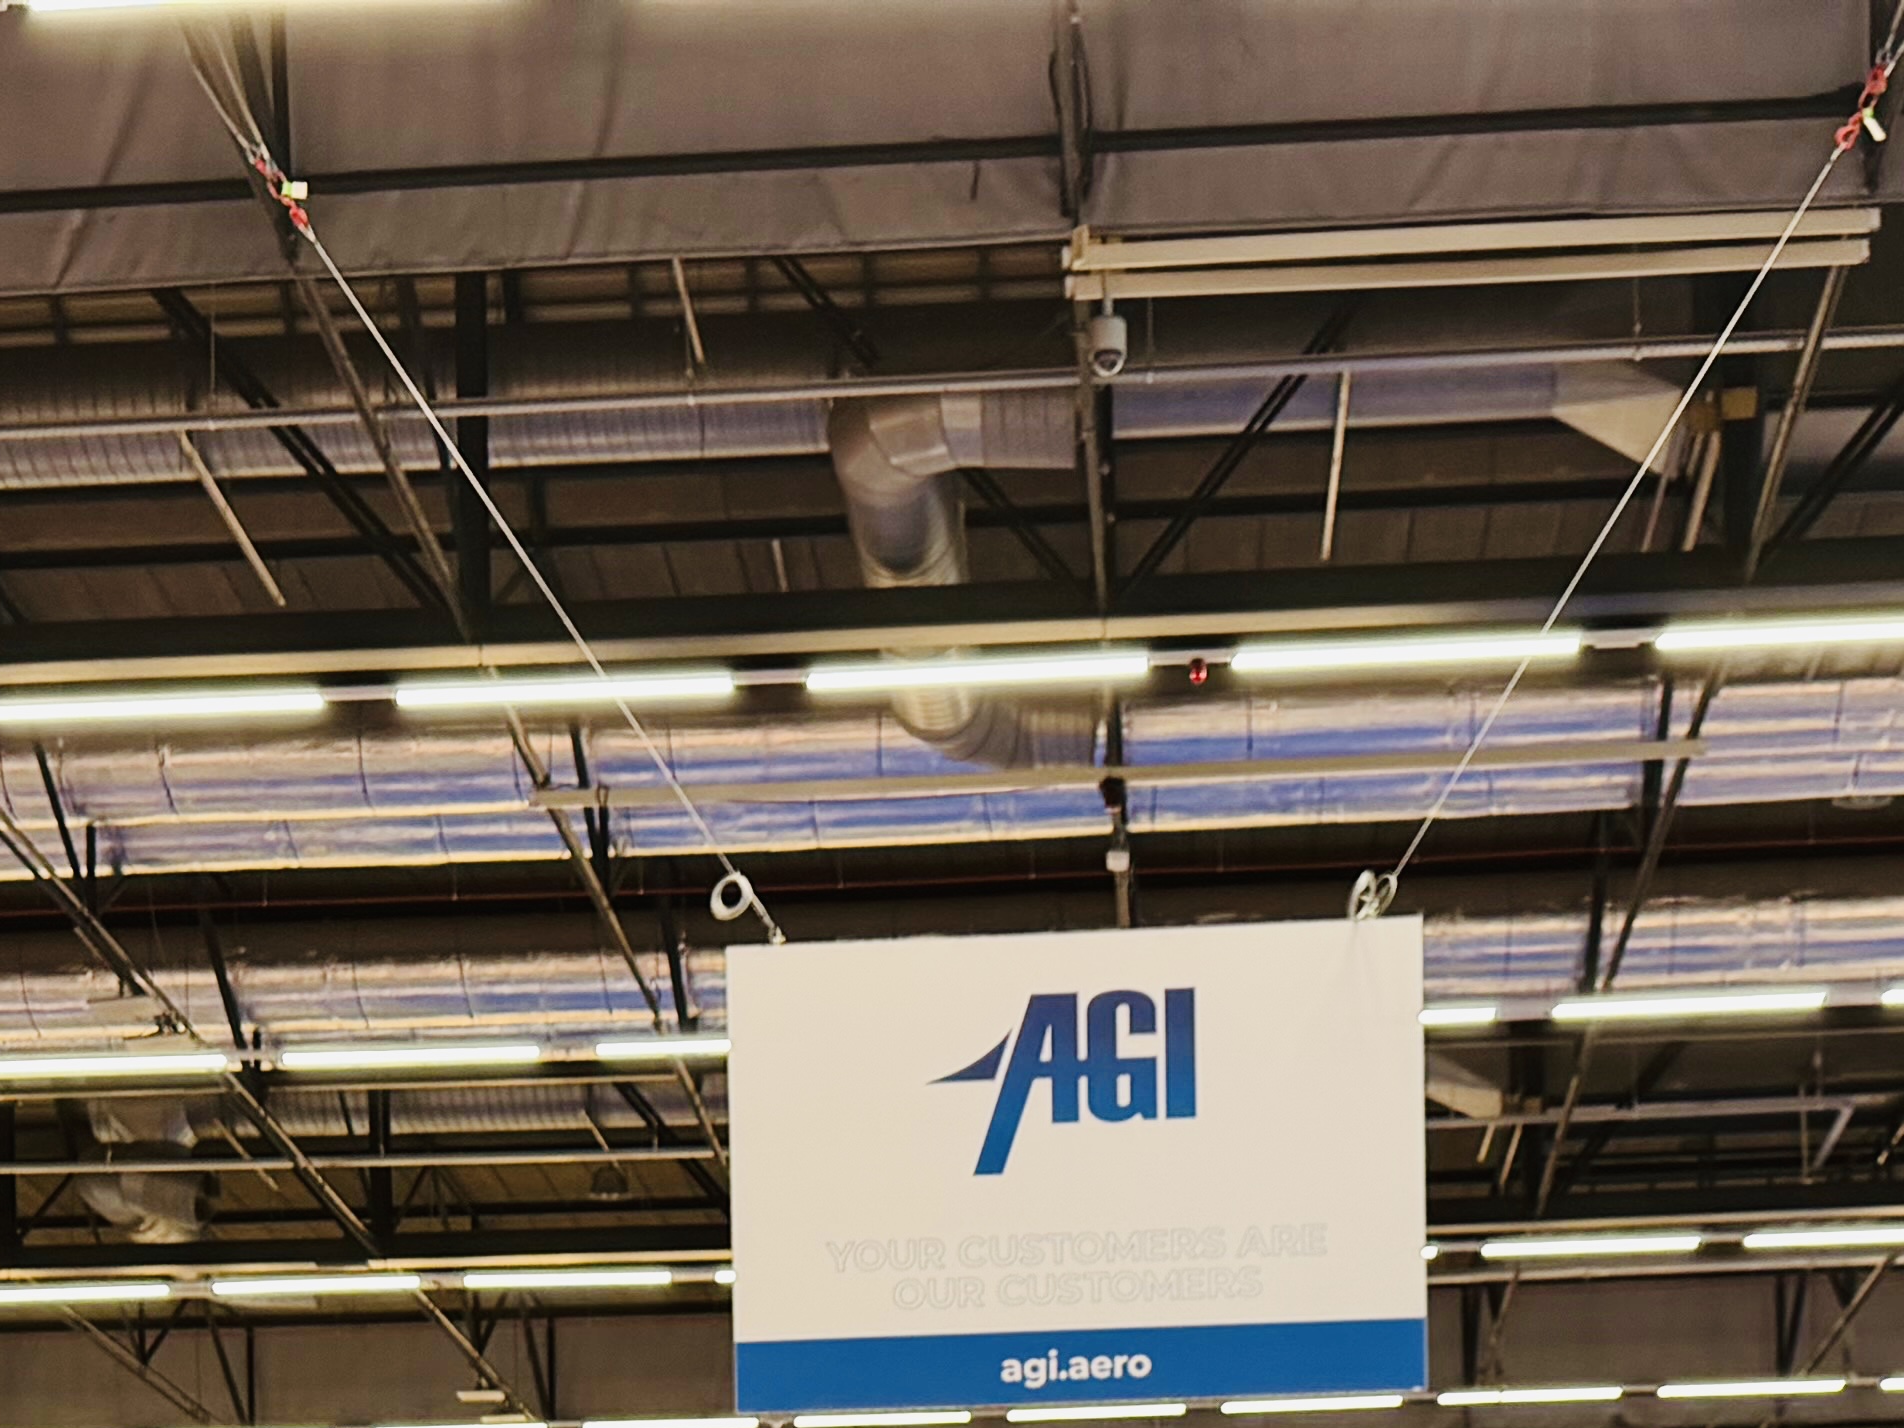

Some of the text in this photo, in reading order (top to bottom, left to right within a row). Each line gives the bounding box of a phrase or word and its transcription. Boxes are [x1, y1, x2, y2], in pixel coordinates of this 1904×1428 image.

[973, 987, 1197, 1176] AGI
[827, 1222, 1330, 1273] YOUR CUSTOMERS ARE
[892, 1264, 1264, 1311] OUR CUSTOMERS
[1000, 1349, 1152, 1389] agi.aero
